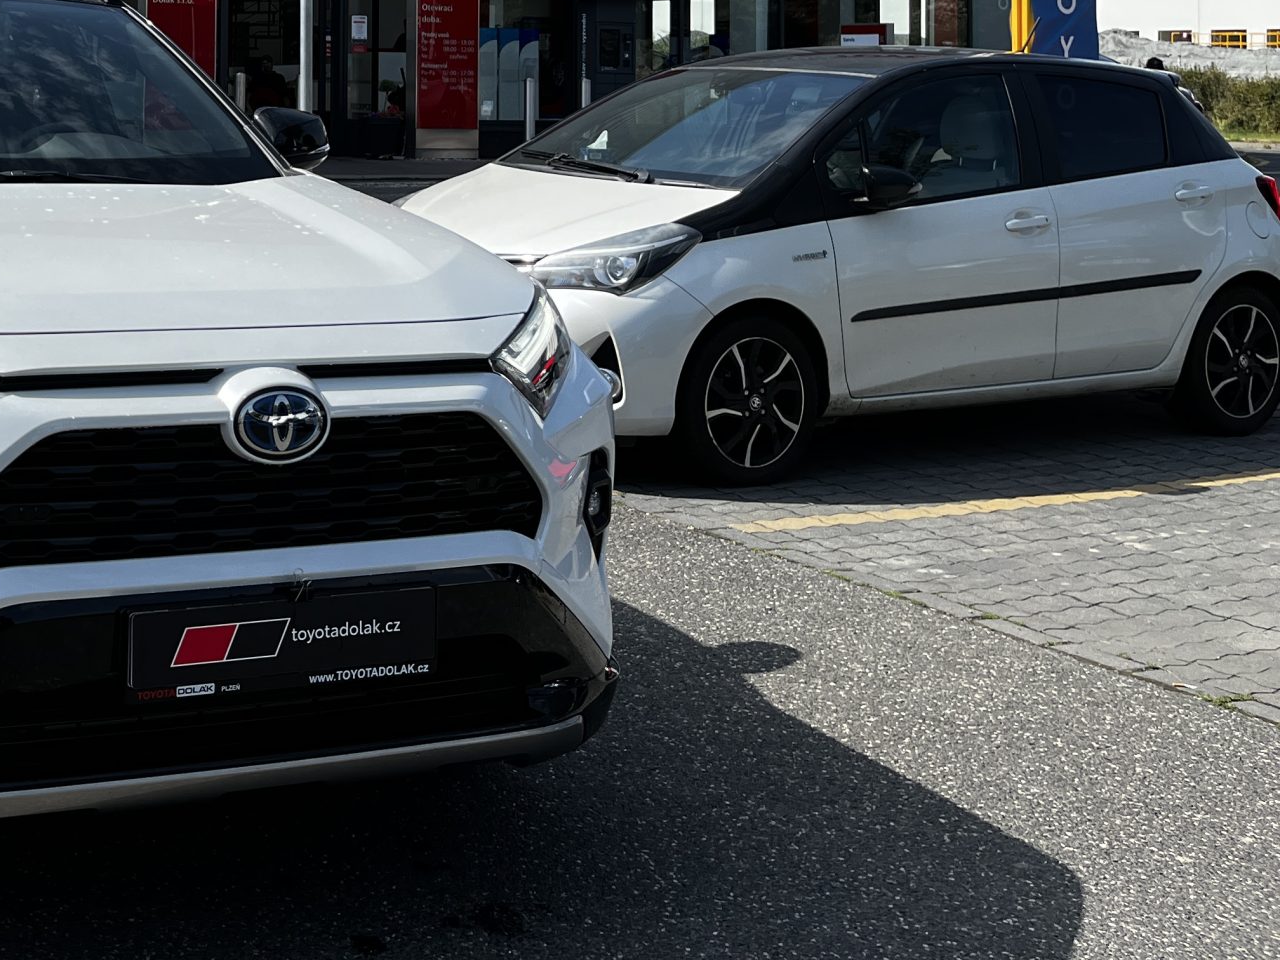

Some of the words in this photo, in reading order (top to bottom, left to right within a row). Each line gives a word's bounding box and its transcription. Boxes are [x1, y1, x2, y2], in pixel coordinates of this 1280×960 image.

[291, 618, 401, 645] toyotadolak.cz
[308, 663, 429, 684] www.TOYOTADOLAK.cz
[137, 689, 176, 701] TOYOTA
